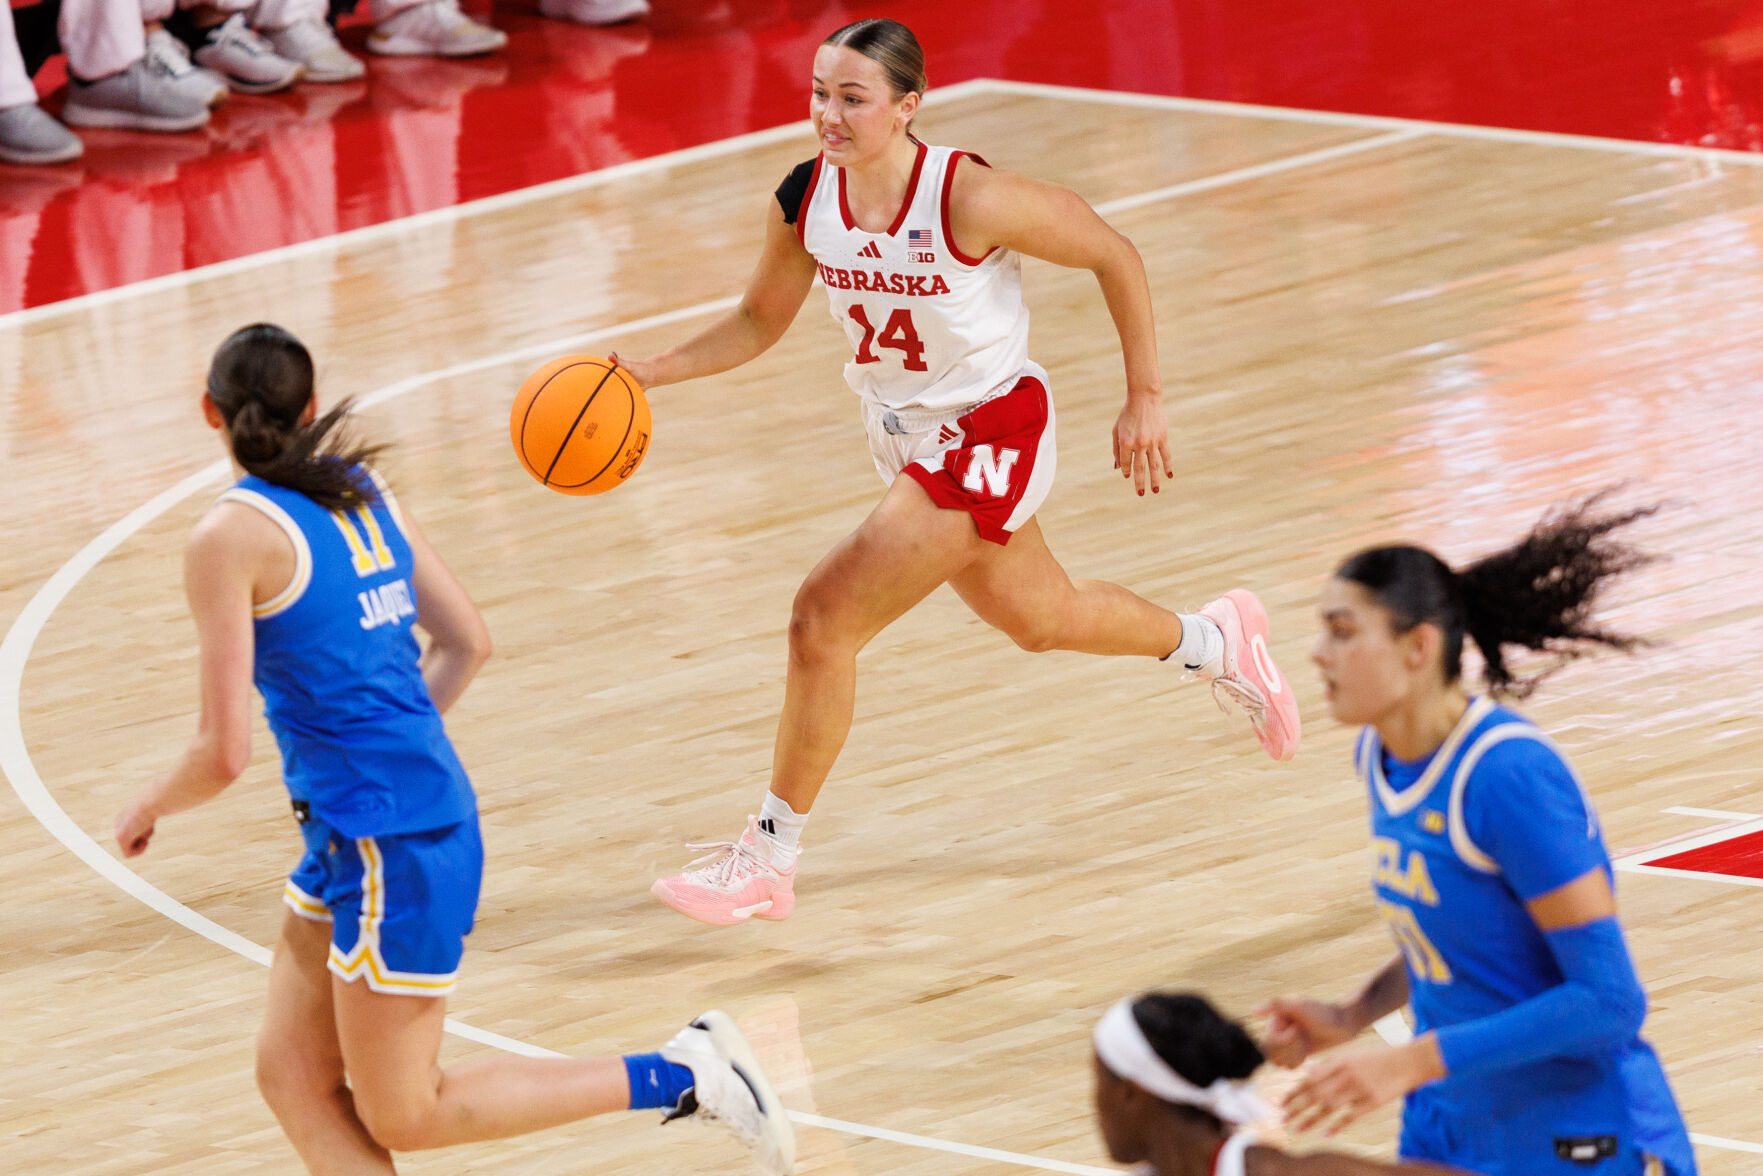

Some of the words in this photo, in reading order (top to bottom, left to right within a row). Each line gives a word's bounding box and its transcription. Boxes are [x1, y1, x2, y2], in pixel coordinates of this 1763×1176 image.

[848, 304, 928, 371] 14
[962, 444, 1020, 498] N
[330, 500, 396, 578] 11
